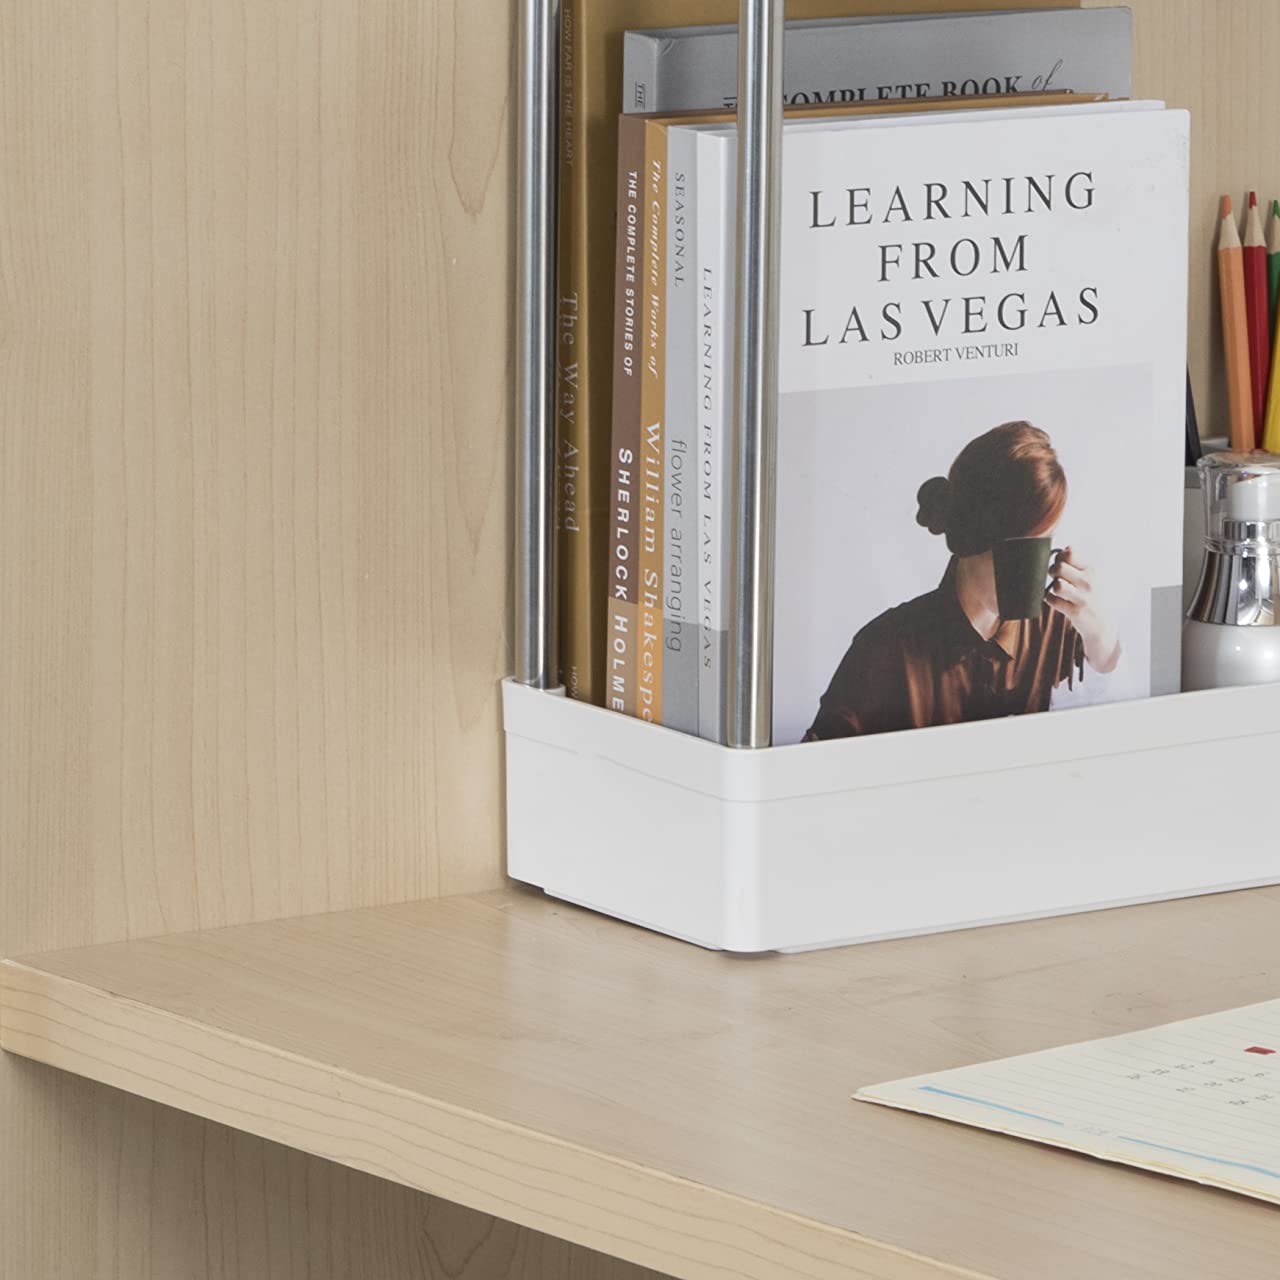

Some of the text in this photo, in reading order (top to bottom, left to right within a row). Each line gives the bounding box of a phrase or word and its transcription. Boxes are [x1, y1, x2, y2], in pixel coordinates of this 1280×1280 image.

[648, 159, 662, 379] The Complete Works of
[674, 172, 686, 287] SEASONAL
[808, 171, 1096, 228] LEARNING
[877, 234, 1028, 282] FROM
[623, 171, 637, 376] THE COMPLETE STORIES OF
[802, 287, 1099, 347] LAS VEGAS
[560, 292, 580, 532] The Way Ahead
[893, 343, 1019, 366] ROBERT VENTURI
[615, 448, 633, 601] SHERLOCK
[645, 422, 660, 553] William
[703, 268, 713, 669] LEARNING FROM LAS VEGAS
[666, 440, 687, 652] flower arranging
